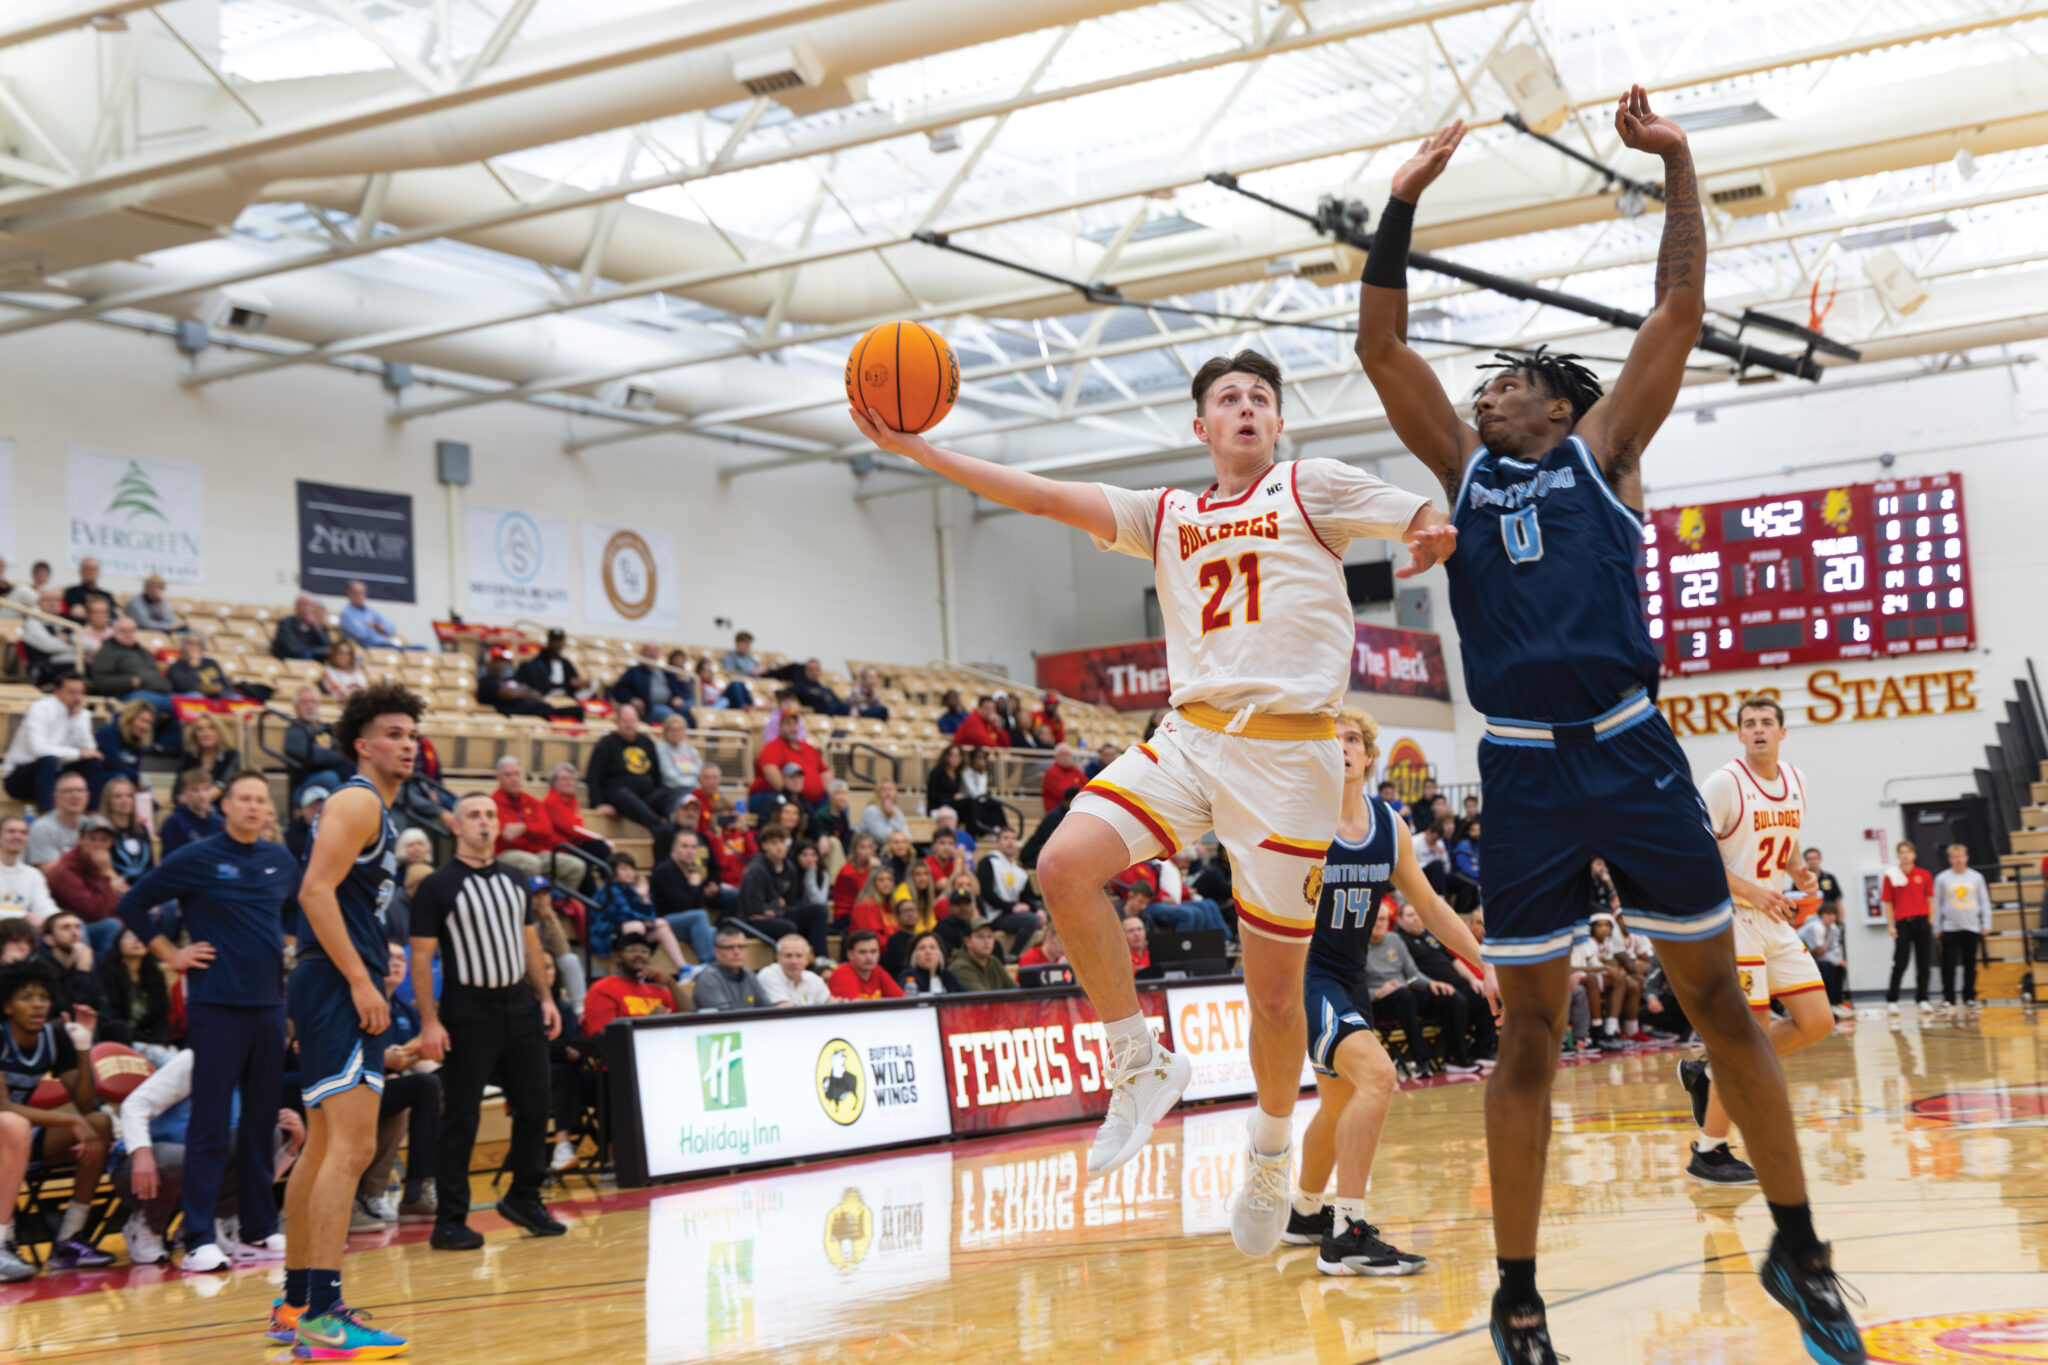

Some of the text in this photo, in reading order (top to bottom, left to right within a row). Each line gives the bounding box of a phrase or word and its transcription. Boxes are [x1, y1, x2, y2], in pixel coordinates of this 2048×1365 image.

[1878, 496, 1899, 516] 11
[1178, 510, 1280, 561] BULLDOGS
[1500, 504, 1545, 565] 0
[1681, 571, 1719, 608] 22
[1823, 555, 1865, 593] 20
[1198, 550, 1262, 637] 21
[1692, 631, 1707, 657] 3
[1853, 616, 1870, 641] 6
[1356, 642, 1386, 677] The
[1106, 663, 1168, 697] The
[1806, 669, 1977, 724] STATE
[1756, 835, 1792, 879] 24
[1331, 888, 1372, 930] 14
[1181, 1000, 1252, 1055] GAT
[869, 1044, 913, 1061] BUFFALO
[948, 1026, 1073, 1109] FERRIS
[871, 1060, 915, 1086] WILD
[873, 1085, 918, 1107] WINGS
[680, 1118, 781, 1155] Holiday Inn
